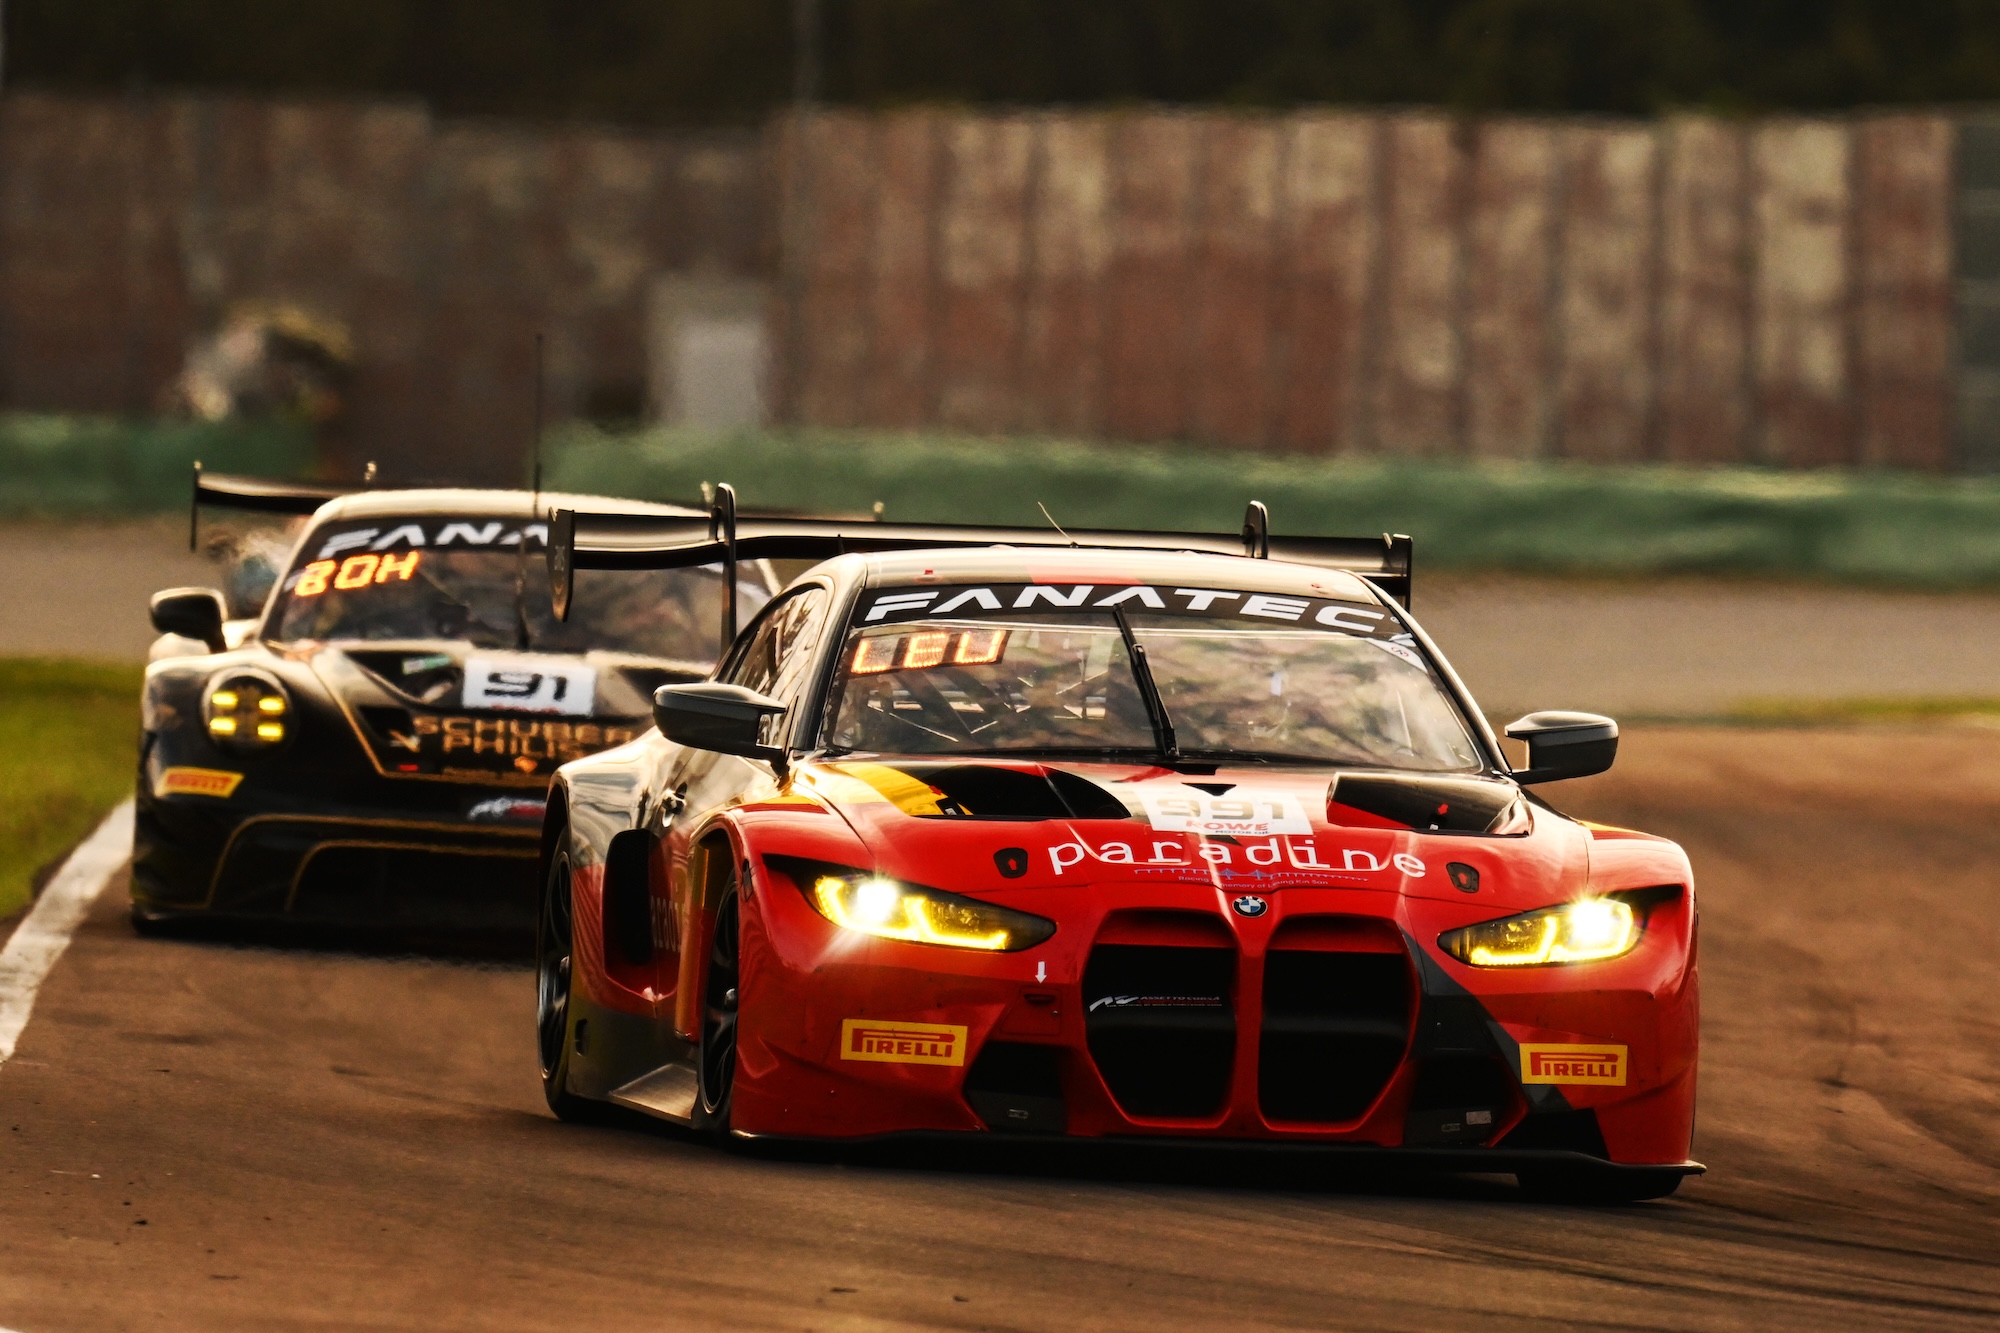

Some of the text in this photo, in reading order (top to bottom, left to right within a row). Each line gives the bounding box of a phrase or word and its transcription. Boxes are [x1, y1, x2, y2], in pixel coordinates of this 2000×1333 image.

[864, 585, 1385, 632] FANATEC
[851, 629, 1006, 674] LEU
[484, 672, 568, 700] 91
[1156, 799, 1284, 820] 991
[1186, 820, 1269, 831] ROWE
[1048, 838, 1426, 878] paradine
[1178, 875, 1209, 883] Racing
[851, 1028, 956, 1058] PIRELLI
[1530, 1052, 1619, 1077] PIRELLI
